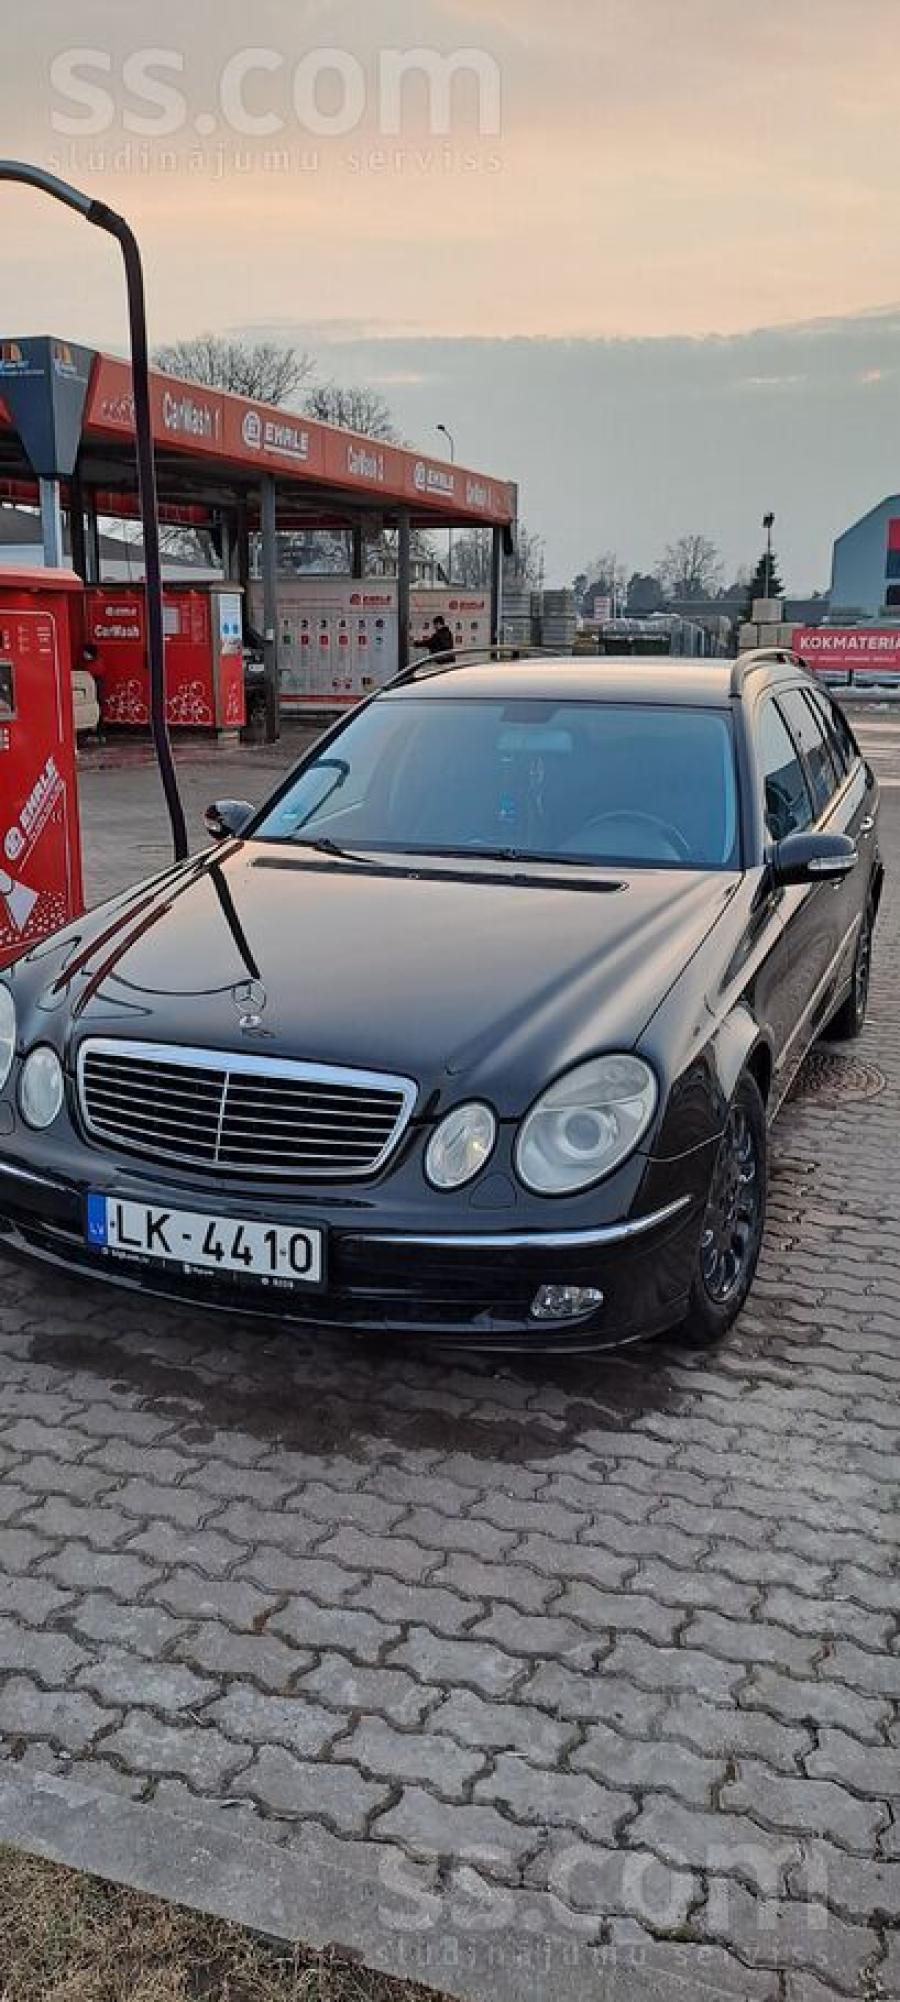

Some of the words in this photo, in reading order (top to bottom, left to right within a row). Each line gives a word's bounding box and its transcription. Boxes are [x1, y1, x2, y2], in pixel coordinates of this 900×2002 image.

[265, 421, 310, 452] EHRLE
[94, 624, 140, 638] CarWash
[116, 1204, 313, 1273] LK-4410
